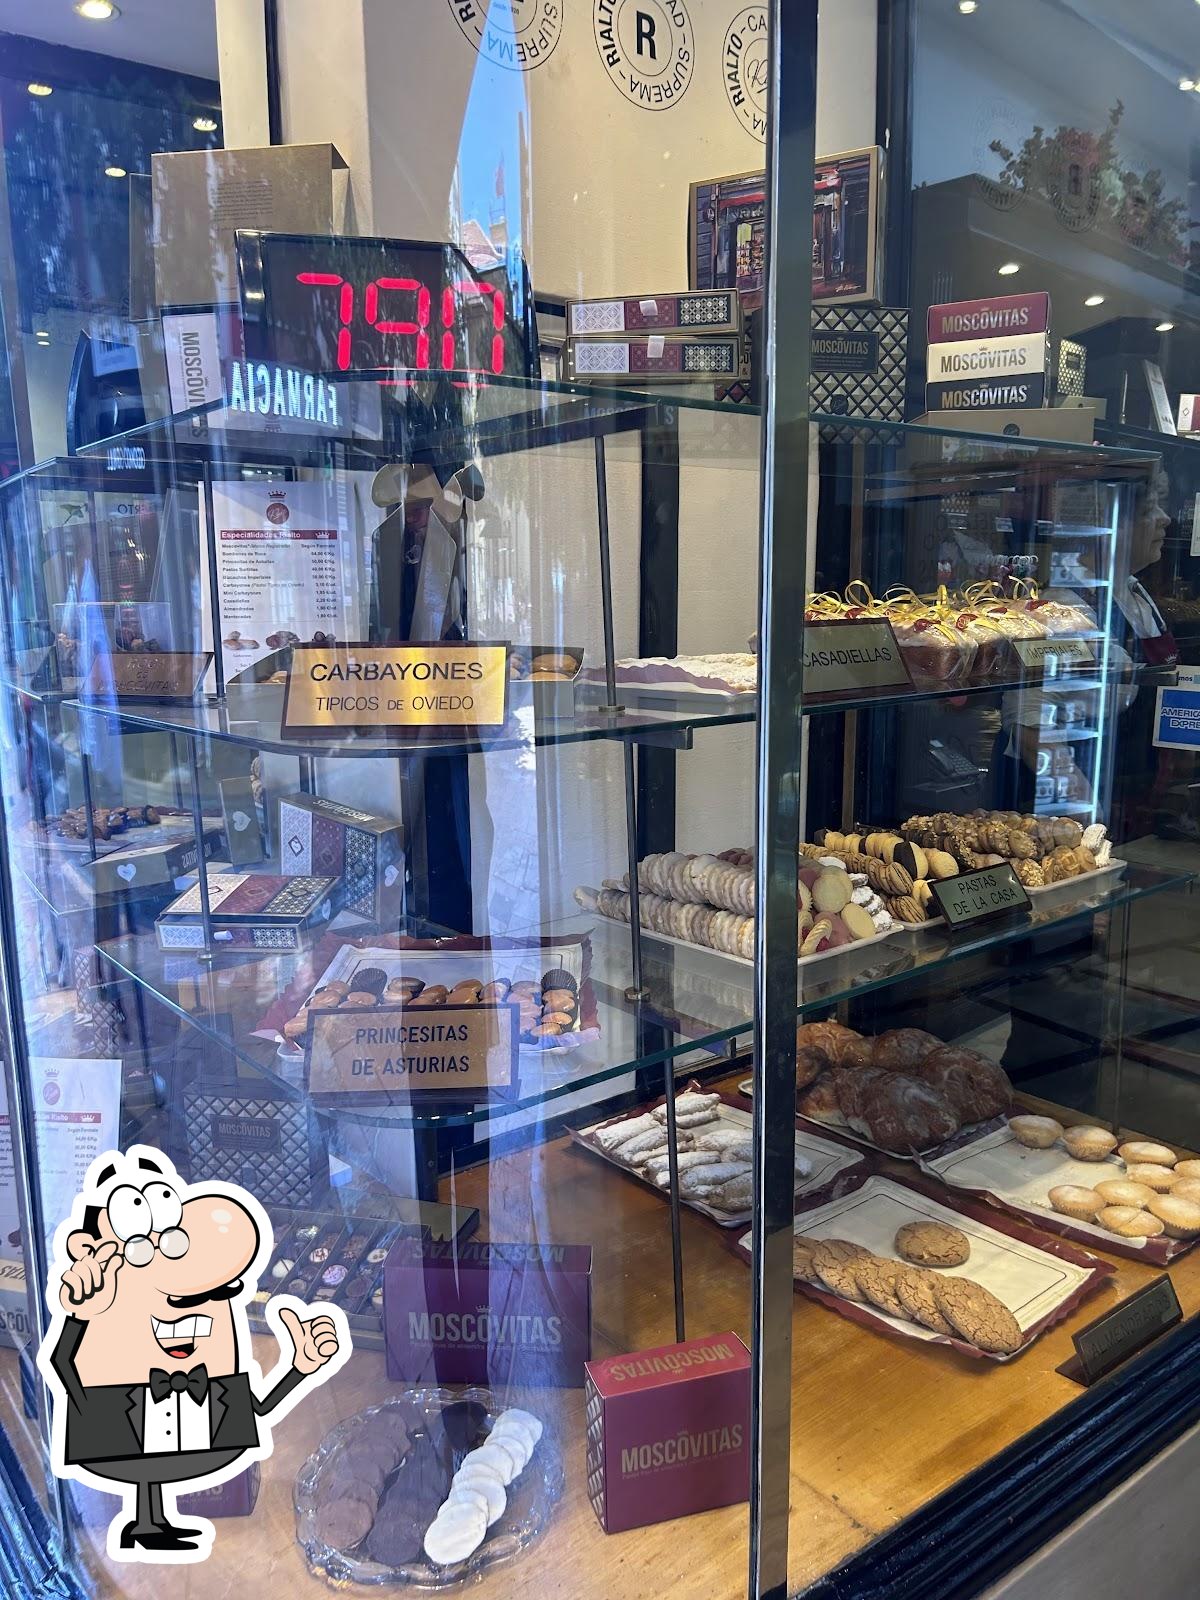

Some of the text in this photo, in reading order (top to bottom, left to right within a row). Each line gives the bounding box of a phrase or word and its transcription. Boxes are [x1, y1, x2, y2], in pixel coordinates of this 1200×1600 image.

[487, 2, 558, 62] SUPREMA
[636, 10, 657, 60] R
[629, 47, 690, 103] SUPREMA
[726, 32, 744, 107] RIALTO
[942, 307, 1029, 335] MOSCOVITAS
[811, 339, 869, 355] MOSCOVITAS
[941, 347, 1027, 373] MOSCOVITAS
[181, 331, 209, 439] MOSCOVIS
[942, 384, 1028, 409] MOSCOVITAS
[802, 647, 892, 668] CASADIELLAS
[1026, 644, 1083, 659] IMPERIALES
[310, 662, 483, 682] CARBAYONES
[315, 696, 379, 711] TIPICOS
[412, 695, 474, 710] OVIEDO
[957, 874, 997, 895] PASTAS
[953, 888, 1018, 916] DE LA CASA
[355, 1024, 468, 1045] PRINCESITAS
[351, 1055, 470, 1076] DE ASTURIAS
[218, 1122, 273, 1138] MOSCOVITAS
[408, 1309, 562, 1346] MOSCOVITAS
[609, 1343, 735, 1381] MOSCOVITAS
[621, 1424, 744, 1474] MOSCOVITAS
